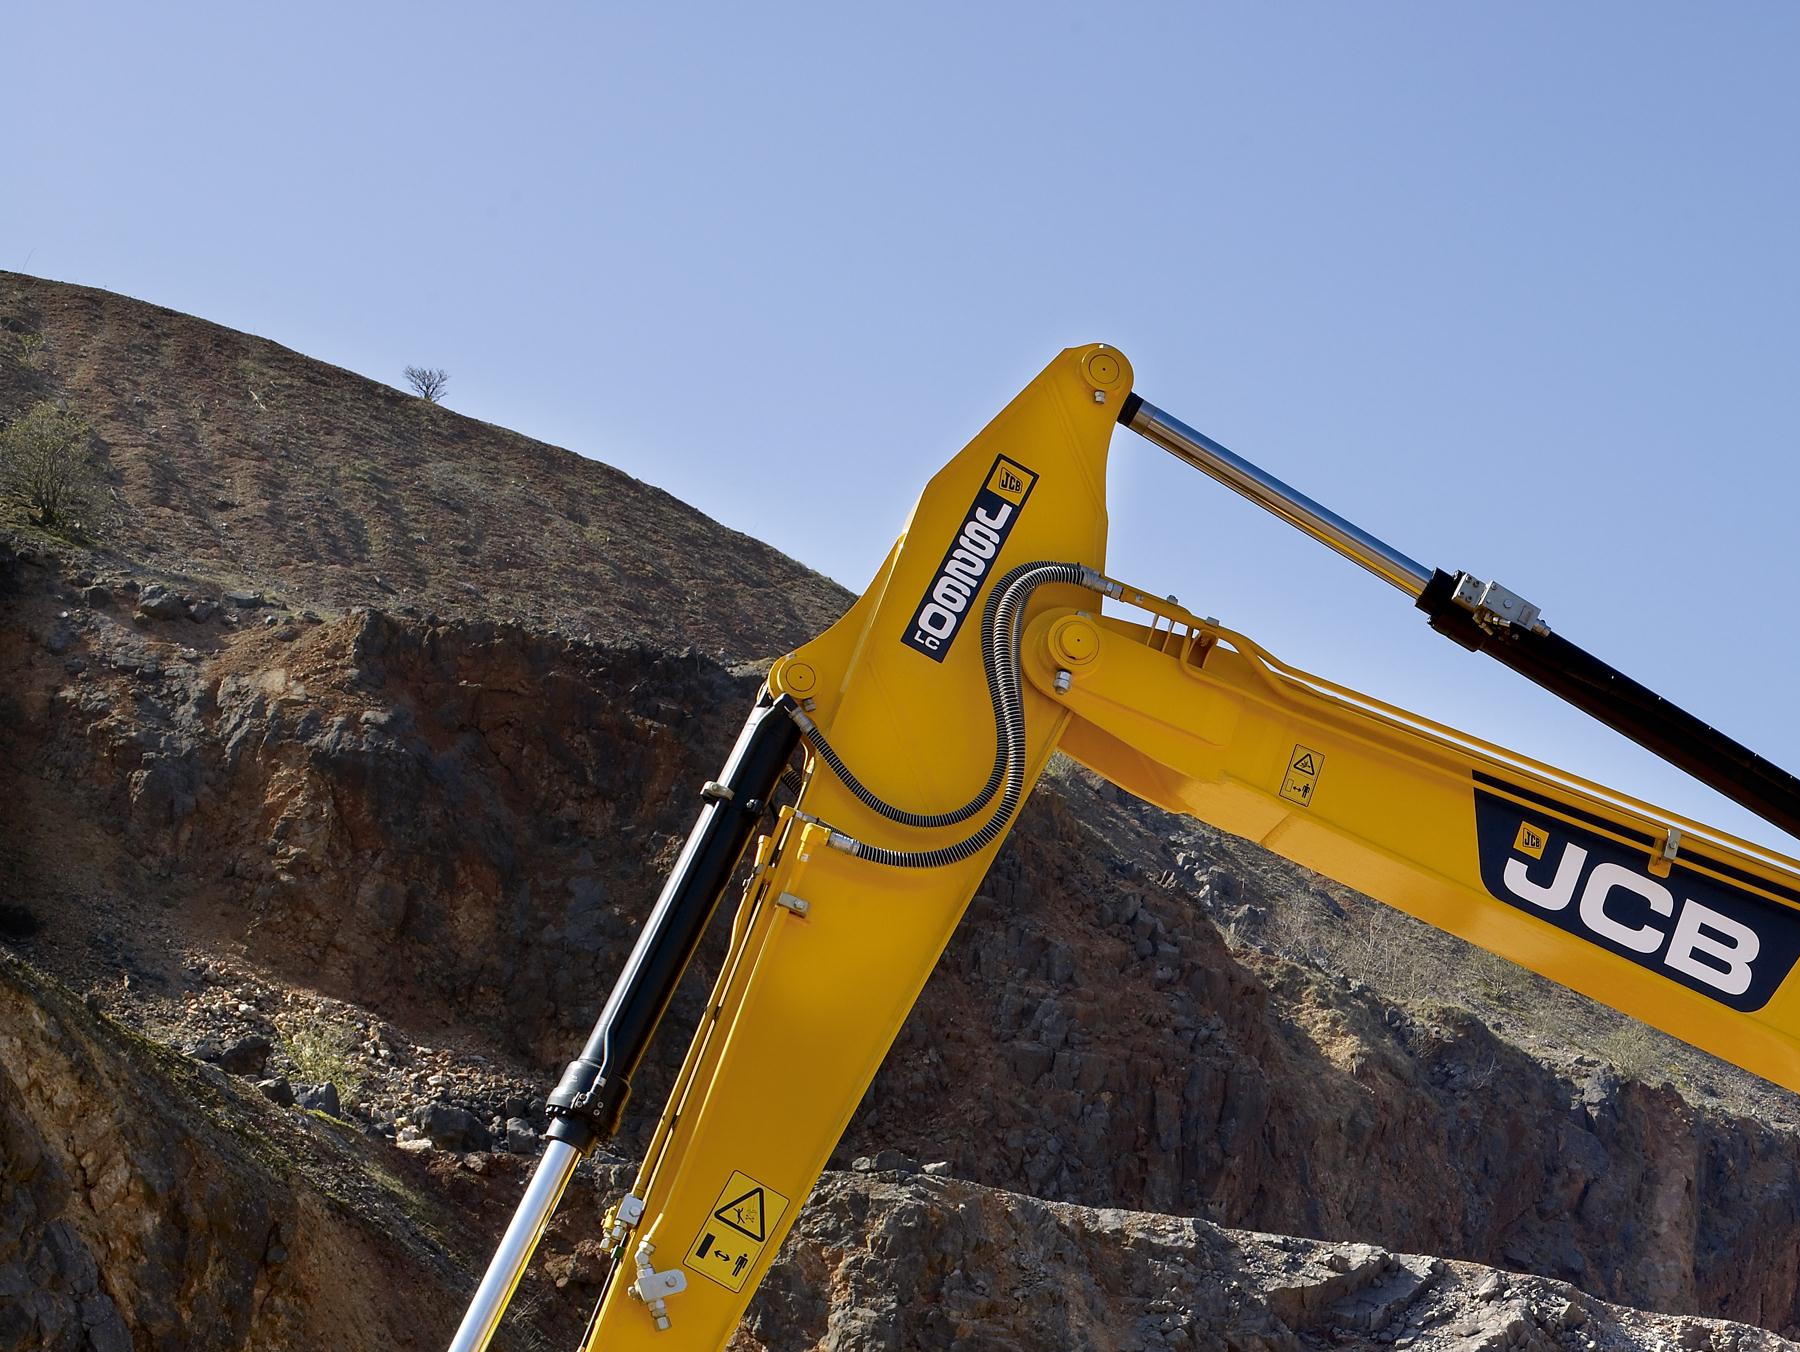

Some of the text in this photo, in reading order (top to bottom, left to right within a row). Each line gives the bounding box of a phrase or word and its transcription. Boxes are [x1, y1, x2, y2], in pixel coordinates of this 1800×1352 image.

[1001, 471, 1021, 493] JCB
[913, 503, 1013, 651] JS260 LC
[1524, 830, 1540, 848] JCB
[1503, 842, 1761, 996] JCB
